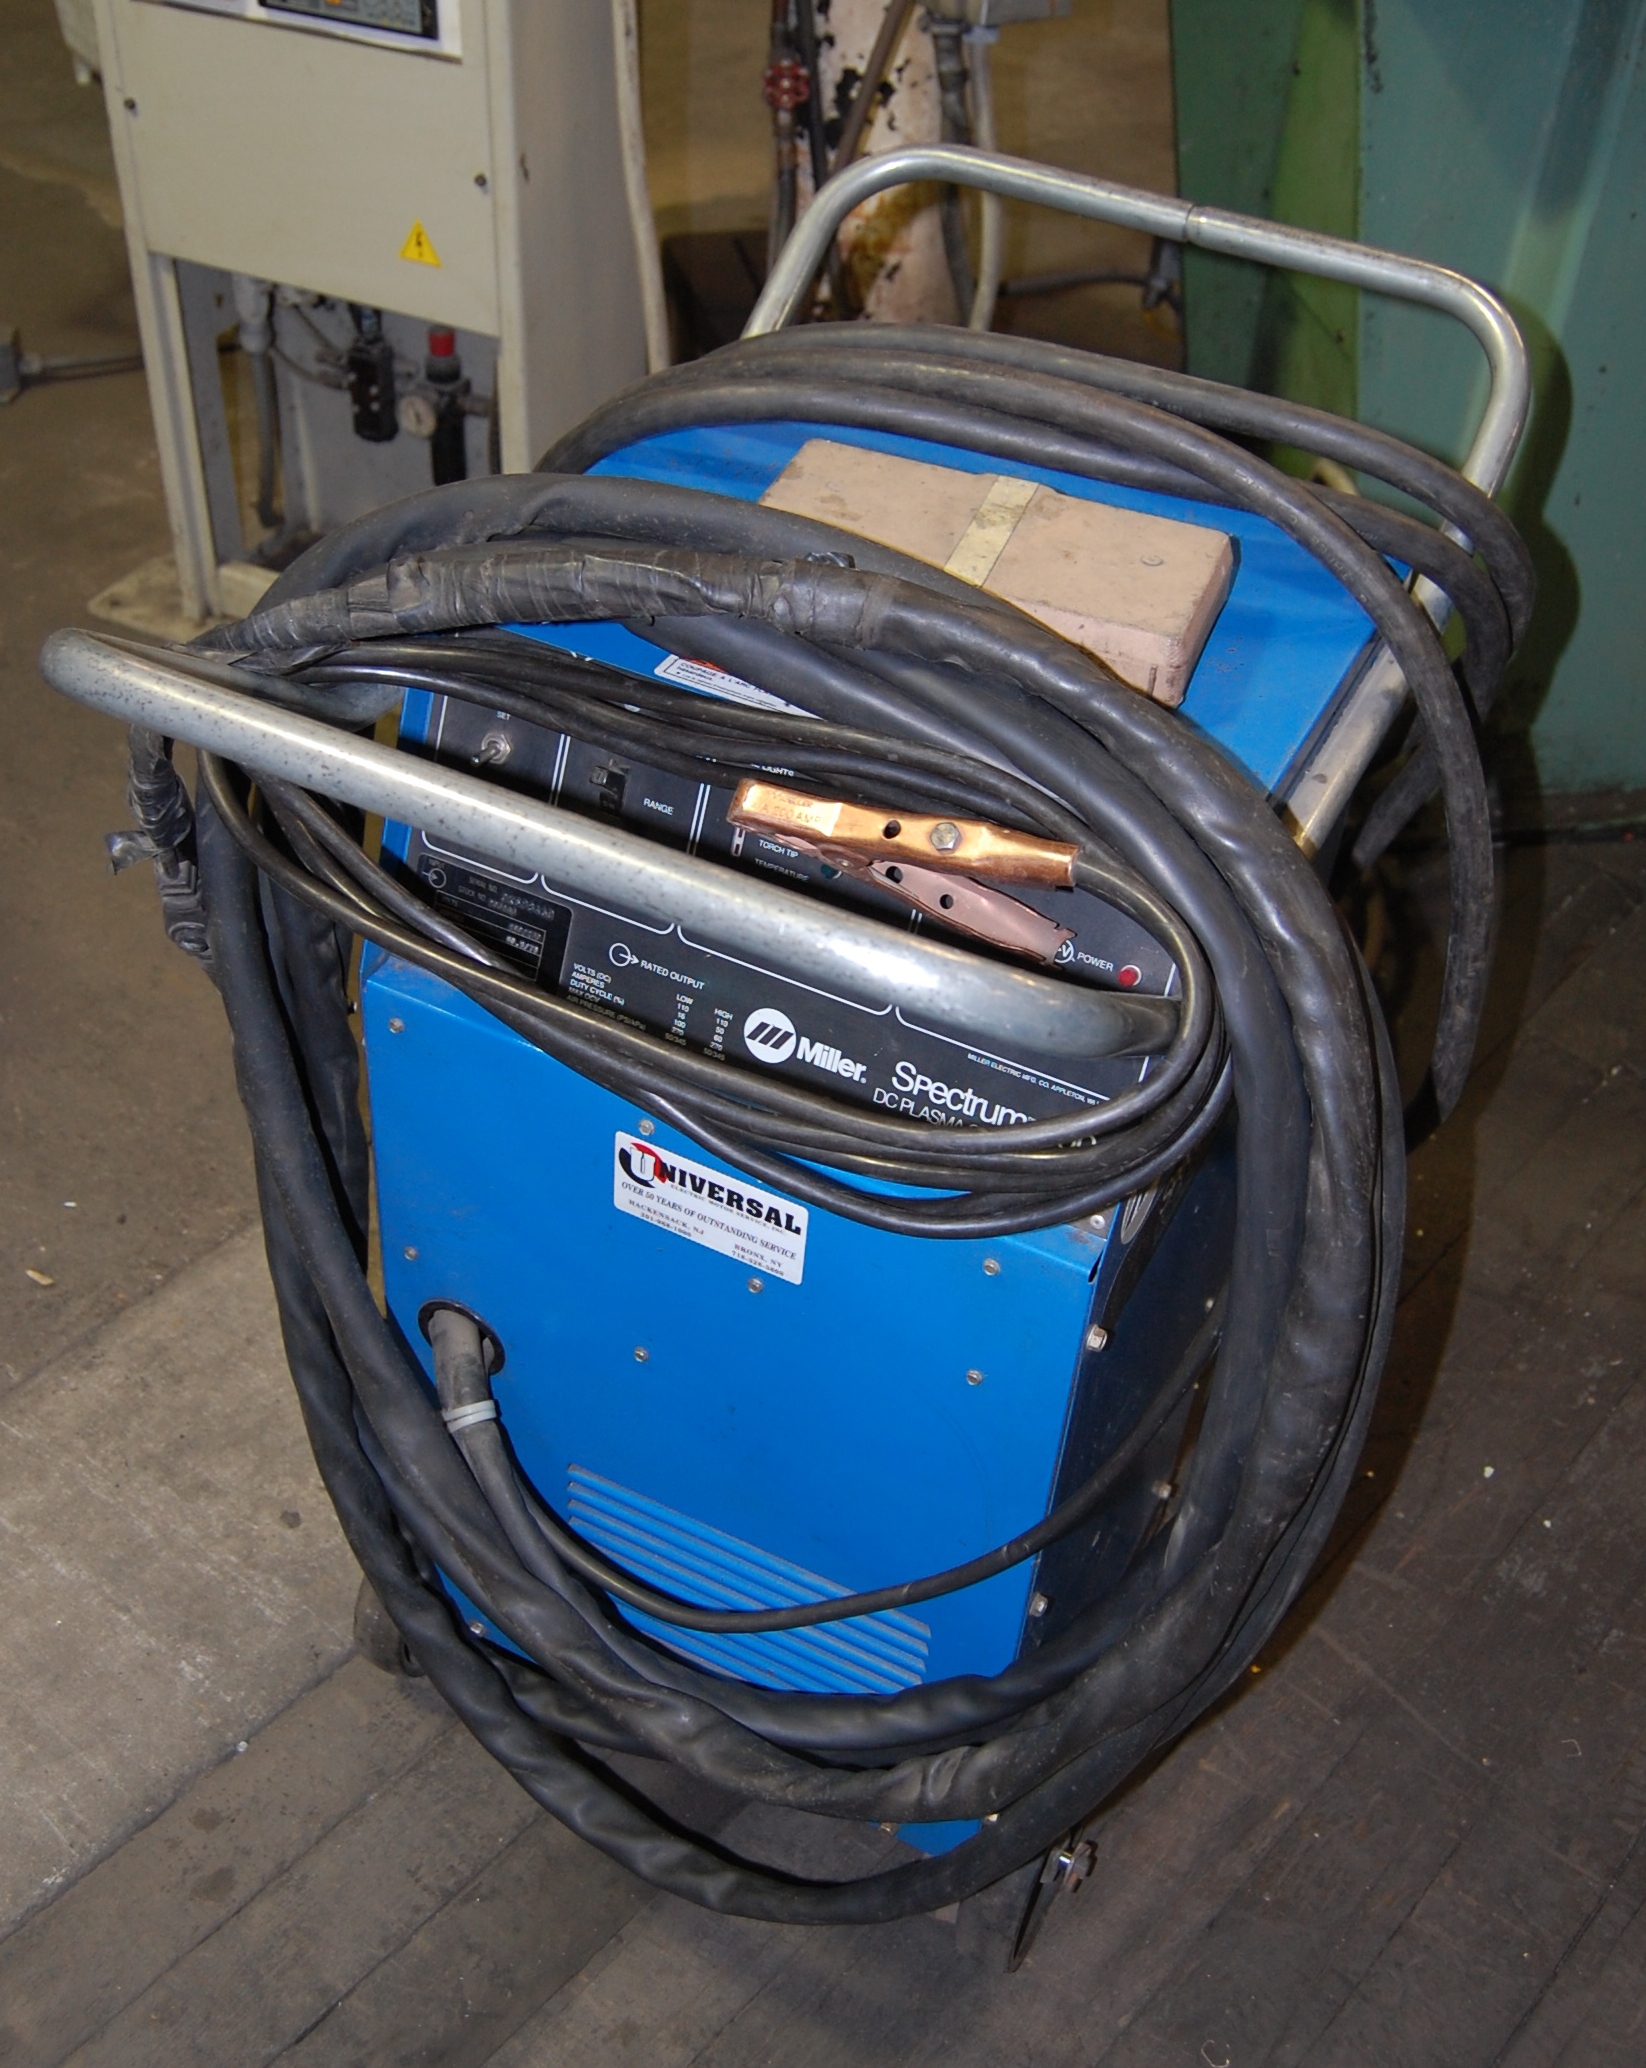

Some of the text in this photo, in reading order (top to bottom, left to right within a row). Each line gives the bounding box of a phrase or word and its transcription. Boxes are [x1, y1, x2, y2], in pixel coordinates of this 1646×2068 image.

[496, 710, 511, 721] SET
[643, 797, 675, 816] RANGE
[758, 839, 799, 858] TORCH TIP
[754, 857, 810, 881] TEMPERATURE
[573, 962, 597, 979] VOLTS
[1077, 951, 1114, 972] POWER
[571, 972, 605, 989] AMPERES
[640, 959, 705, 991] RATED OUTPUT
[570, 979, 589, 992] DUTY
[589, 986, 613, 1001] CYCLE
[676, 993, 694, 1005] LOW
[714, 1007, 733, 1021] HIGH
[967, 1053, 991, 1067] MILLER
[990, 1062, 1022, 1078] ELECTRIC
[873, 1087, 899, 1109] DC
[620, 1143, 801, 1235] UNIVERSAL
[621, 1181, 797, 1260] OVER 50 YEARS OF OUTSTANDING SERVICE
[770, 1258, 783, 1268] NY
